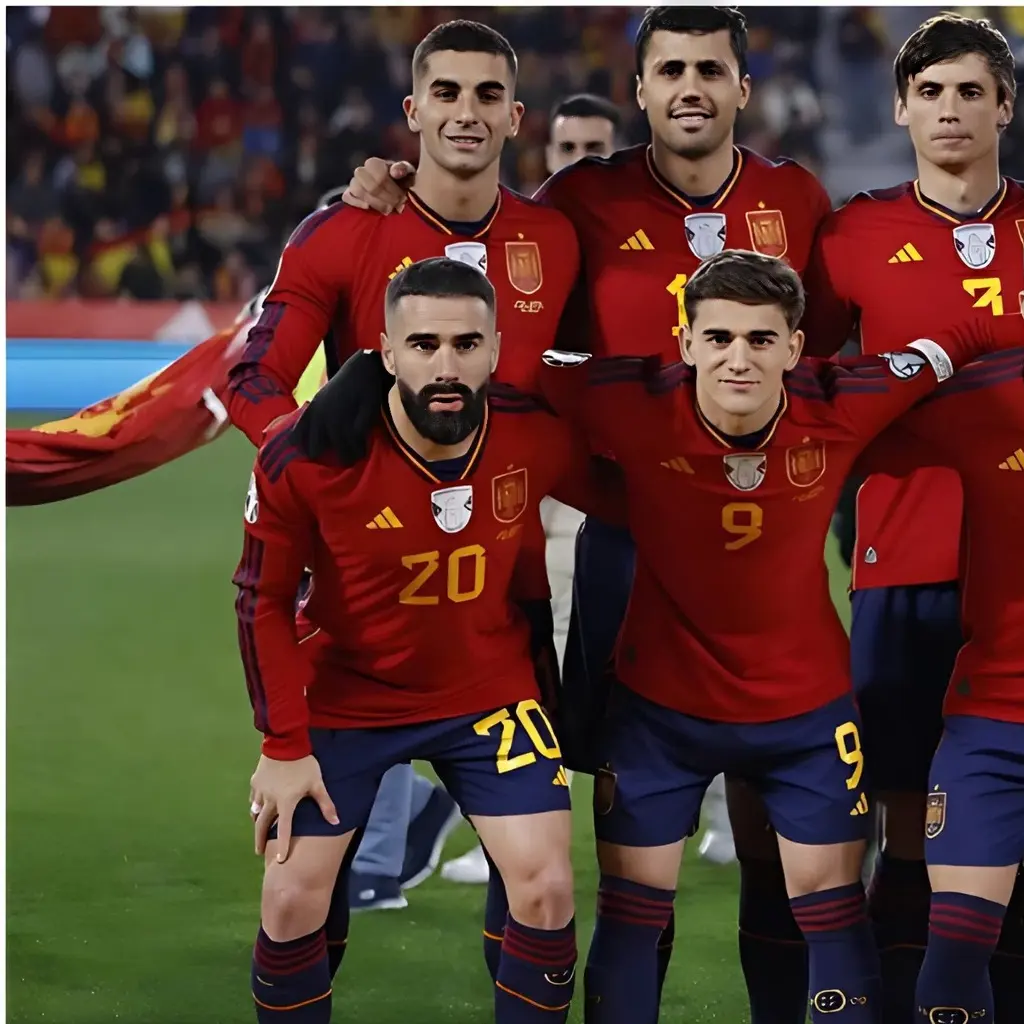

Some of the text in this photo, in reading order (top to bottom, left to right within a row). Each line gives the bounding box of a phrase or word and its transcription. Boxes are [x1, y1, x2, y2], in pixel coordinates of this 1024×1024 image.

[722, 502, 763, 550] 9
[400, 544, 486, 605] 20
[472, 699, 562, 773] 20
[834, 721, 865, 790] 9
